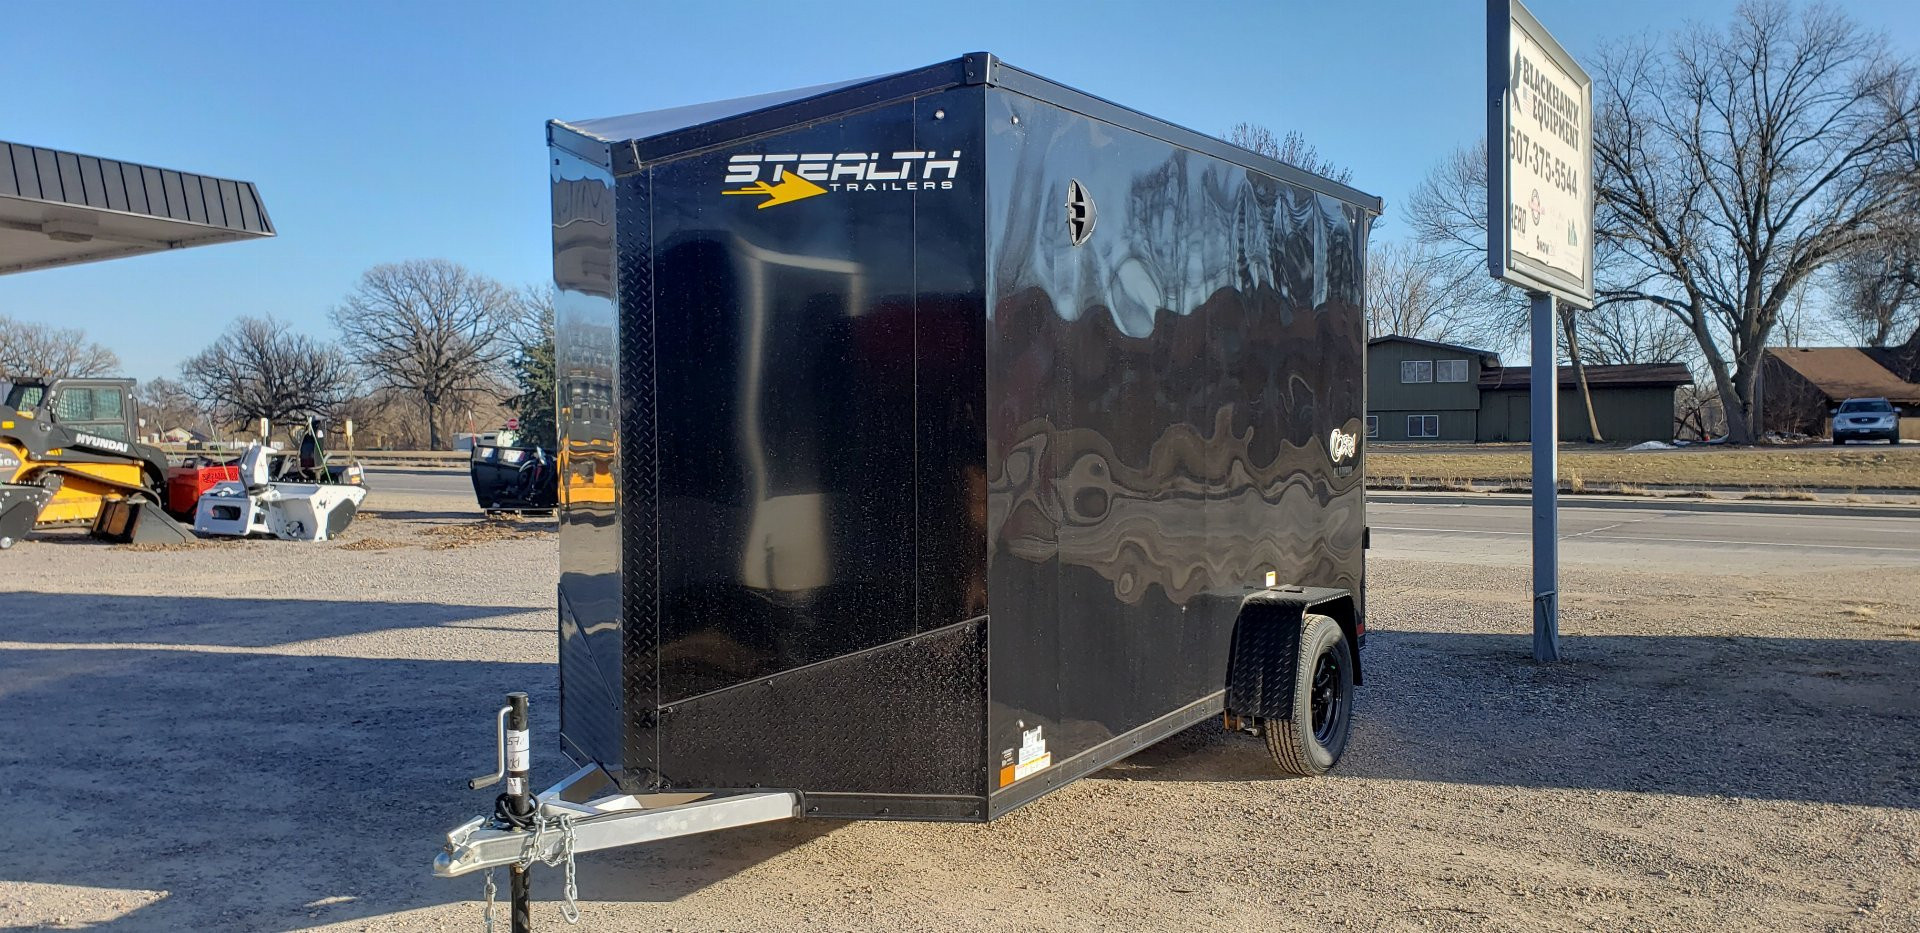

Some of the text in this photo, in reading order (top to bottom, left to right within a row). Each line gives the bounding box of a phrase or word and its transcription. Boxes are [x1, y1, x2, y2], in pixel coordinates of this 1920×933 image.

[1522, 56, 1579, 128] BLACKHAWK
[1532, 94, 1579, 152] EQUIPMENT
[725, 151, 961, 183] STEALTH
[1510, 125, 1578, 200] 507-375-5544
[829, 181, 953, 192] TRAILERS
[76, 433, 128, 453] HYUNDAI
